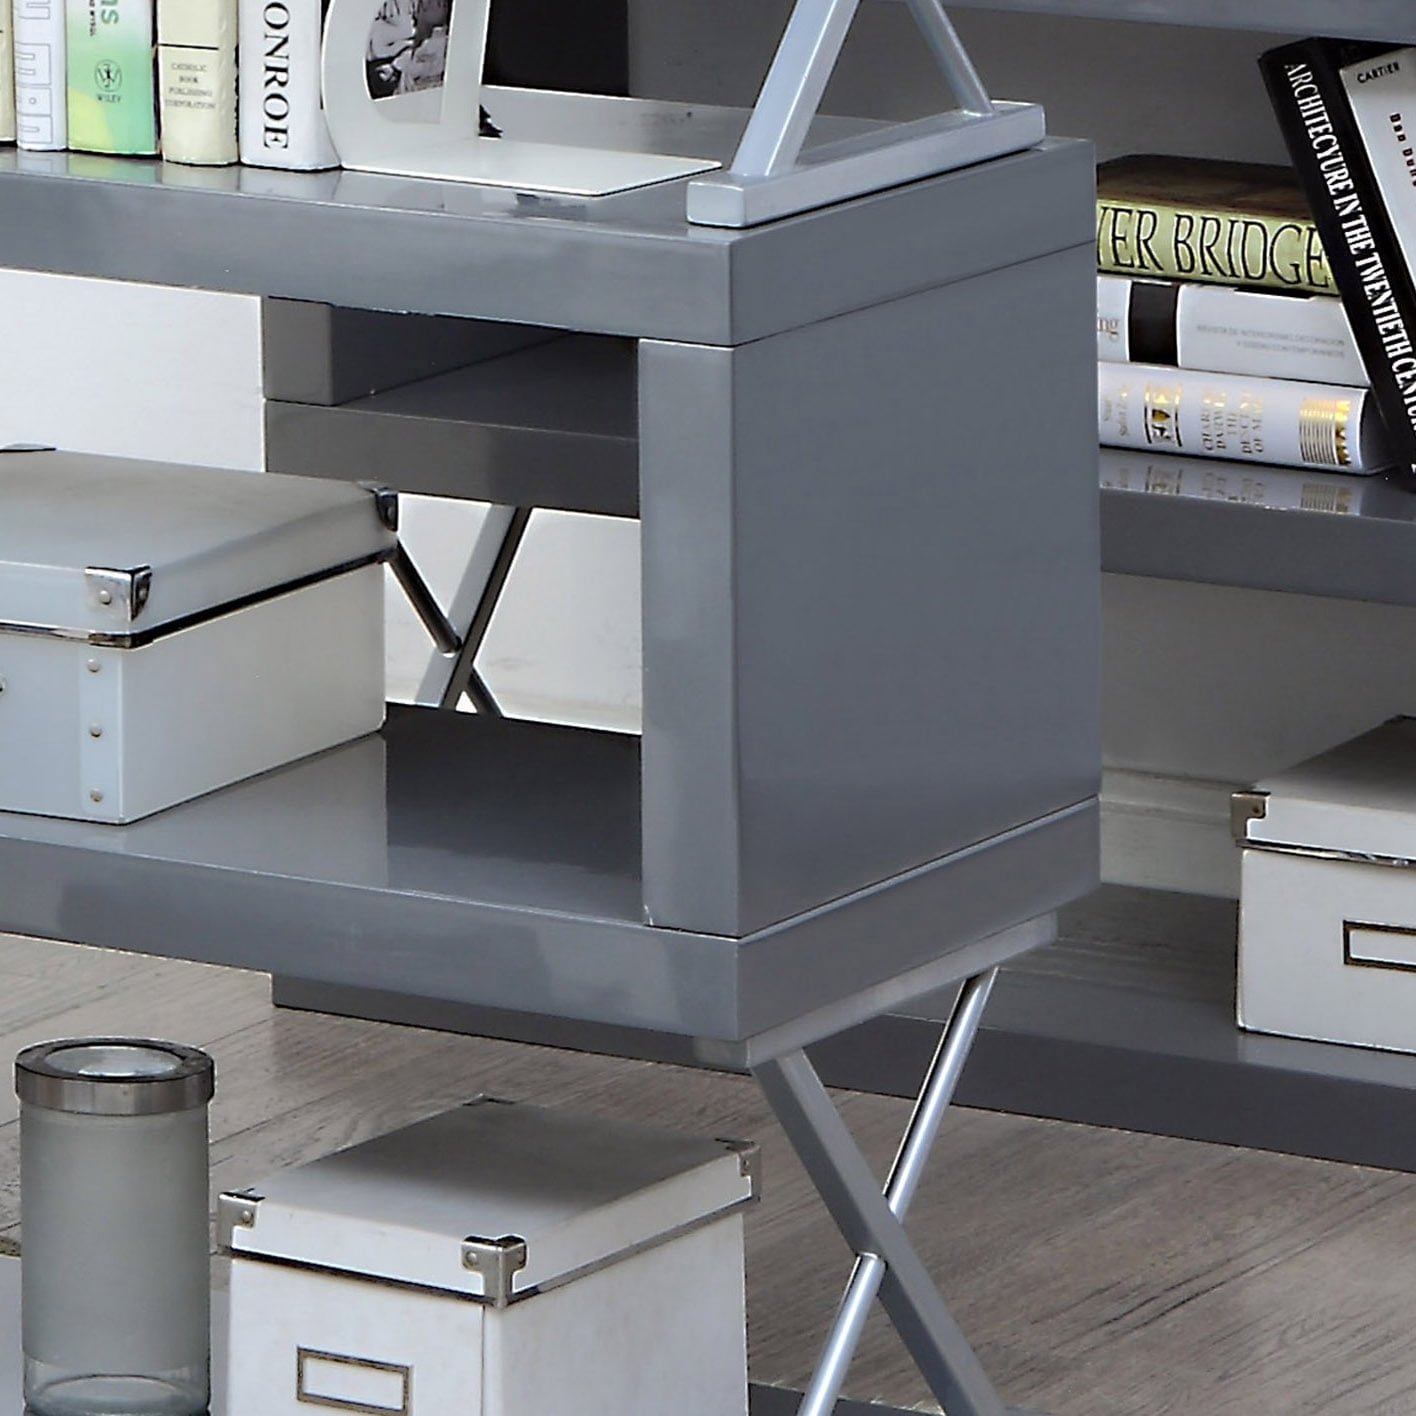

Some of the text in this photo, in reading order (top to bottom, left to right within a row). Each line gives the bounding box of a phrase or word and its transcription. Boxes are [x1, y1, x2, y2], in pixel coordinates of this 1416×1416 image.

[1356, 61, 1400, 84] CARTIER
[1334, 192, 1363, 217] IN
[1341, 215, 1374, 259] THE
[1355, 251, 1412, 359] TWENTIETH
